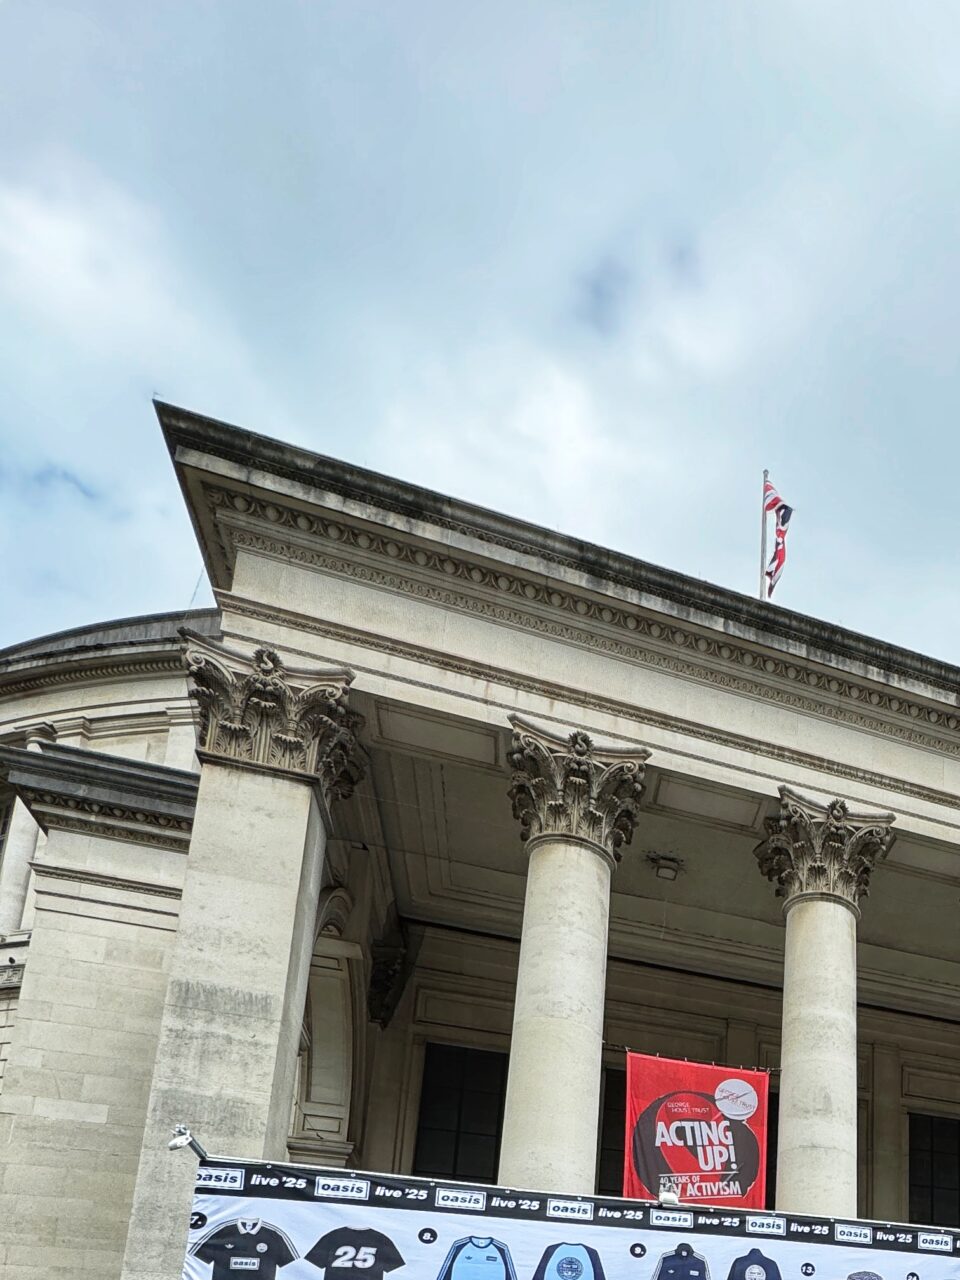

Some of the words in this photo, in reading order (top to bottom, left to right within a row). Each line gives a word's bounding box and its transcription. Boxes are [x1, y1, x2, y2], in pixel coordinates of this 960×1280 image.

[655, 1121, 733, 1146] ACTING
[697, 1146, 737, 1170] UP!
[686, 1181, 742, 1196] ACTIVISM
[191, 1216, 201, 1224] 7.
[251, 1174, 280, 1186] live
[321, 1183, 364, 1194] oasis
[375, 1186, 403, 1199] live
[441, 1194, 481, 1205] oasis
[491, 1197, 516, 1208] live
[552, 1204, 589, 1216] oasis
[598, 1208, 621, 1219] live
[655, 1214, 689, 1224] oasis
[698, 1216, 720, 1225] live
[750, 1220, 782, 1231] oasis
[790, 1223, 810, 1234] live
[838, 1229, 869, 1240] oasis
[876, 1231, 895, 1242] live
[921, 1237, 950, 1247] oasis
[423, 1232, 434, 1240] 8.
[332, 1246, 377, 1269] 25
